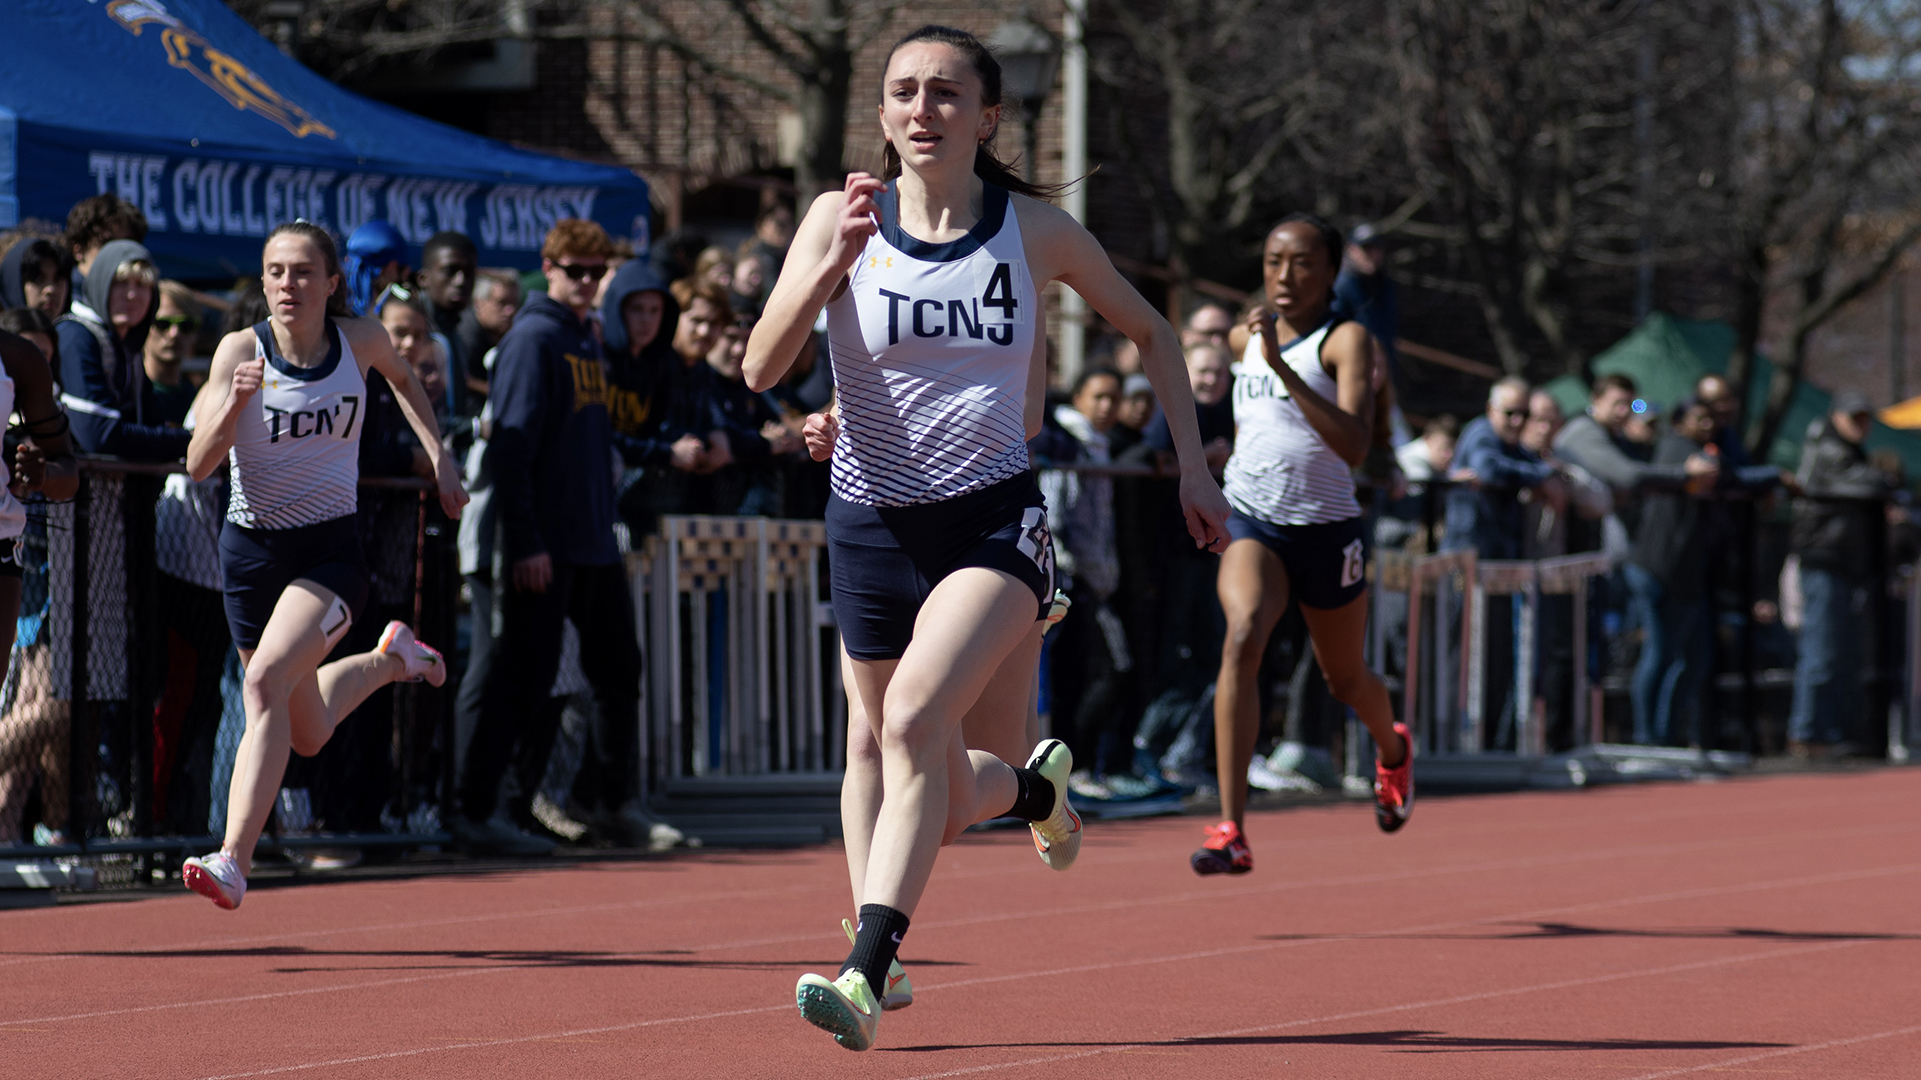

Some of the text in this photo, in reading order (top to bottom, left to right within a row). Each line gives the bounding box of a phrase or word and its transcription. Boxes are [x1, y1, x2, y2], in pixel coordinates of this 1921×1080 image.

[88, 152, 169, 231] THE
[172, 156, 337, 237] COLLEGE
[336, 172, 388, 242] OF
[385, 175, 481, 244] NEW
[479, 181, 600, 250] JERSEY
[982, 262, 1018, 319] 4
[341, 395, 359, 439] 7
